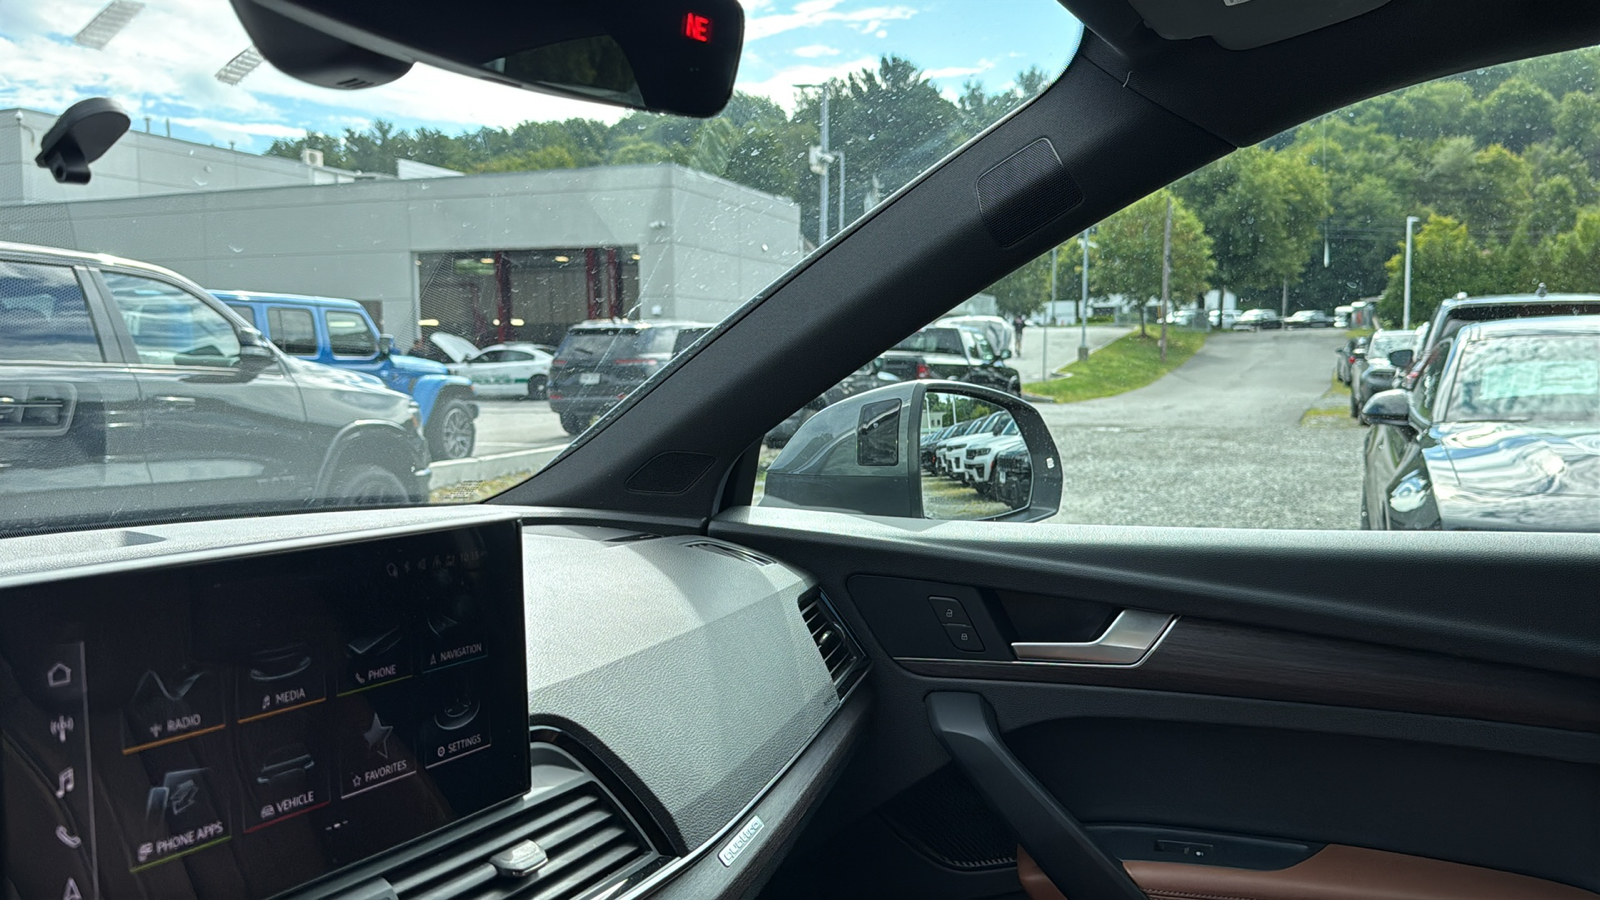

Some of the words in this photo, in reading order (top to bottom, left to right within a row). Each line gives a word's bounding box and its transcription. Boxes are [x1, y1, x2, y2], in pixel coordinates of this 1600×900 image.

[686, 13, 709, 42] NE
[440, 643, 482, 661] NAVIGATION
[368, 664, 396, 680] PHONE
[275, 688, 306, 704] MEDIA
[167, 714, 201, 732] RADIO
[448, 734, 482, 753] SETTINGS
[364, 760, 407, 782] FAVORITES
[276, 790, 314, 813] VEHICLE
[156, 831, 195, 855] PHONE
[196, 821, 224, 841] APPS
